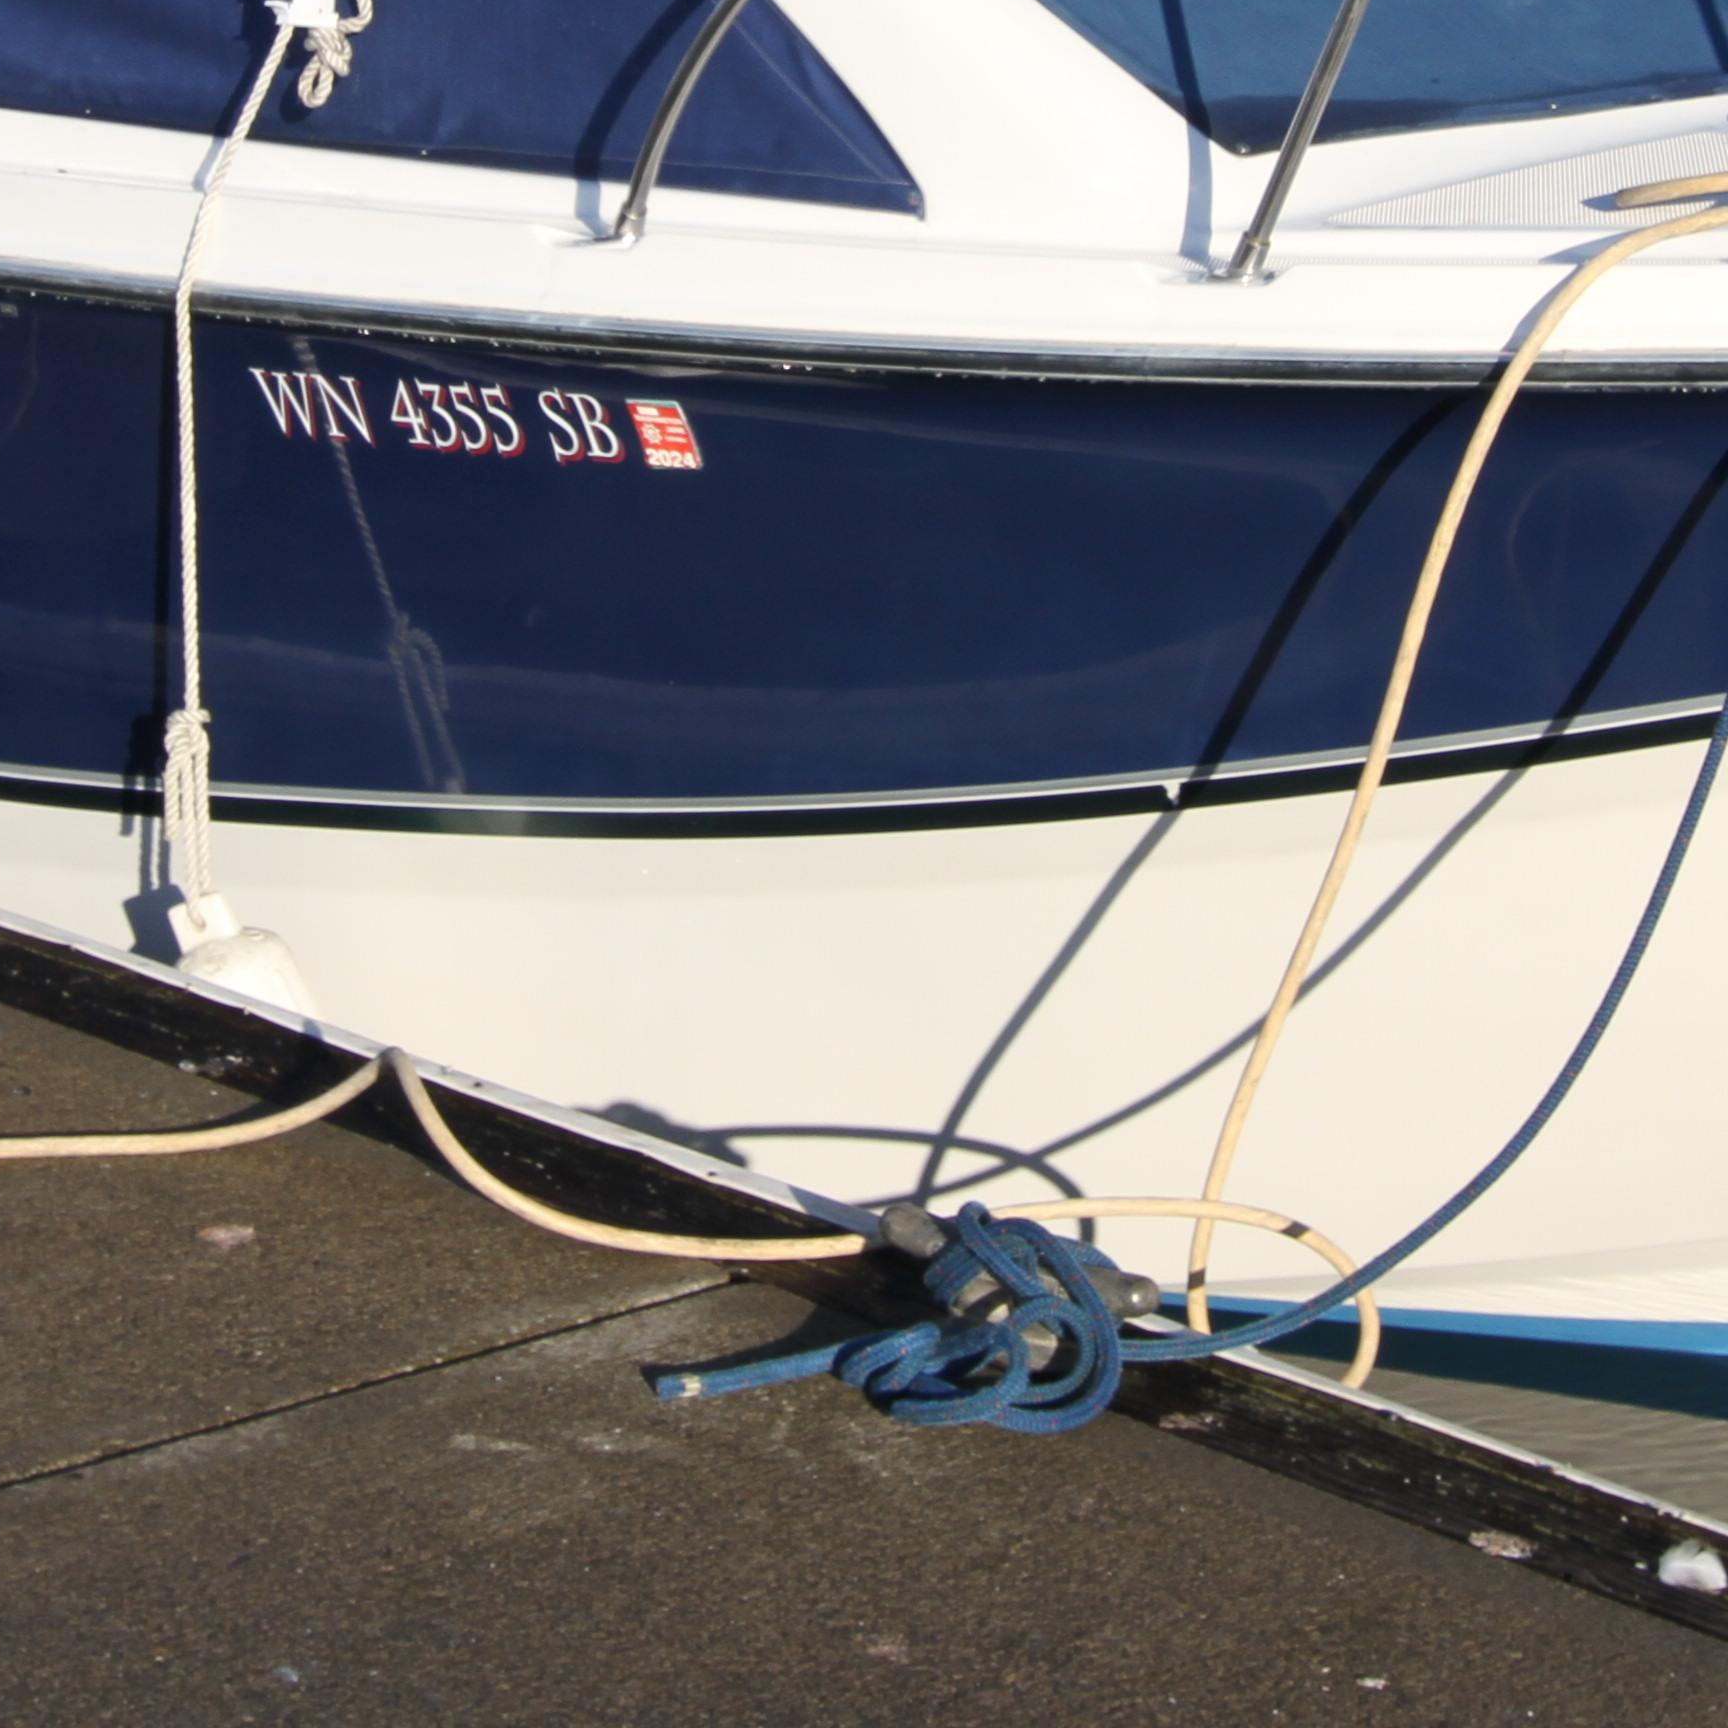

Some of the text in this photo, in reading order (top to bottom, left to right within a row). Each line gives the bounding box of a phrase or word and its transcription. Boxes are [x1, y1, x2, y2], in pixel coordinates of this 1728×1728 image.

[248, 366, 626, 465] WN 4355 SB
[645, 448, 698, 469] 2024
